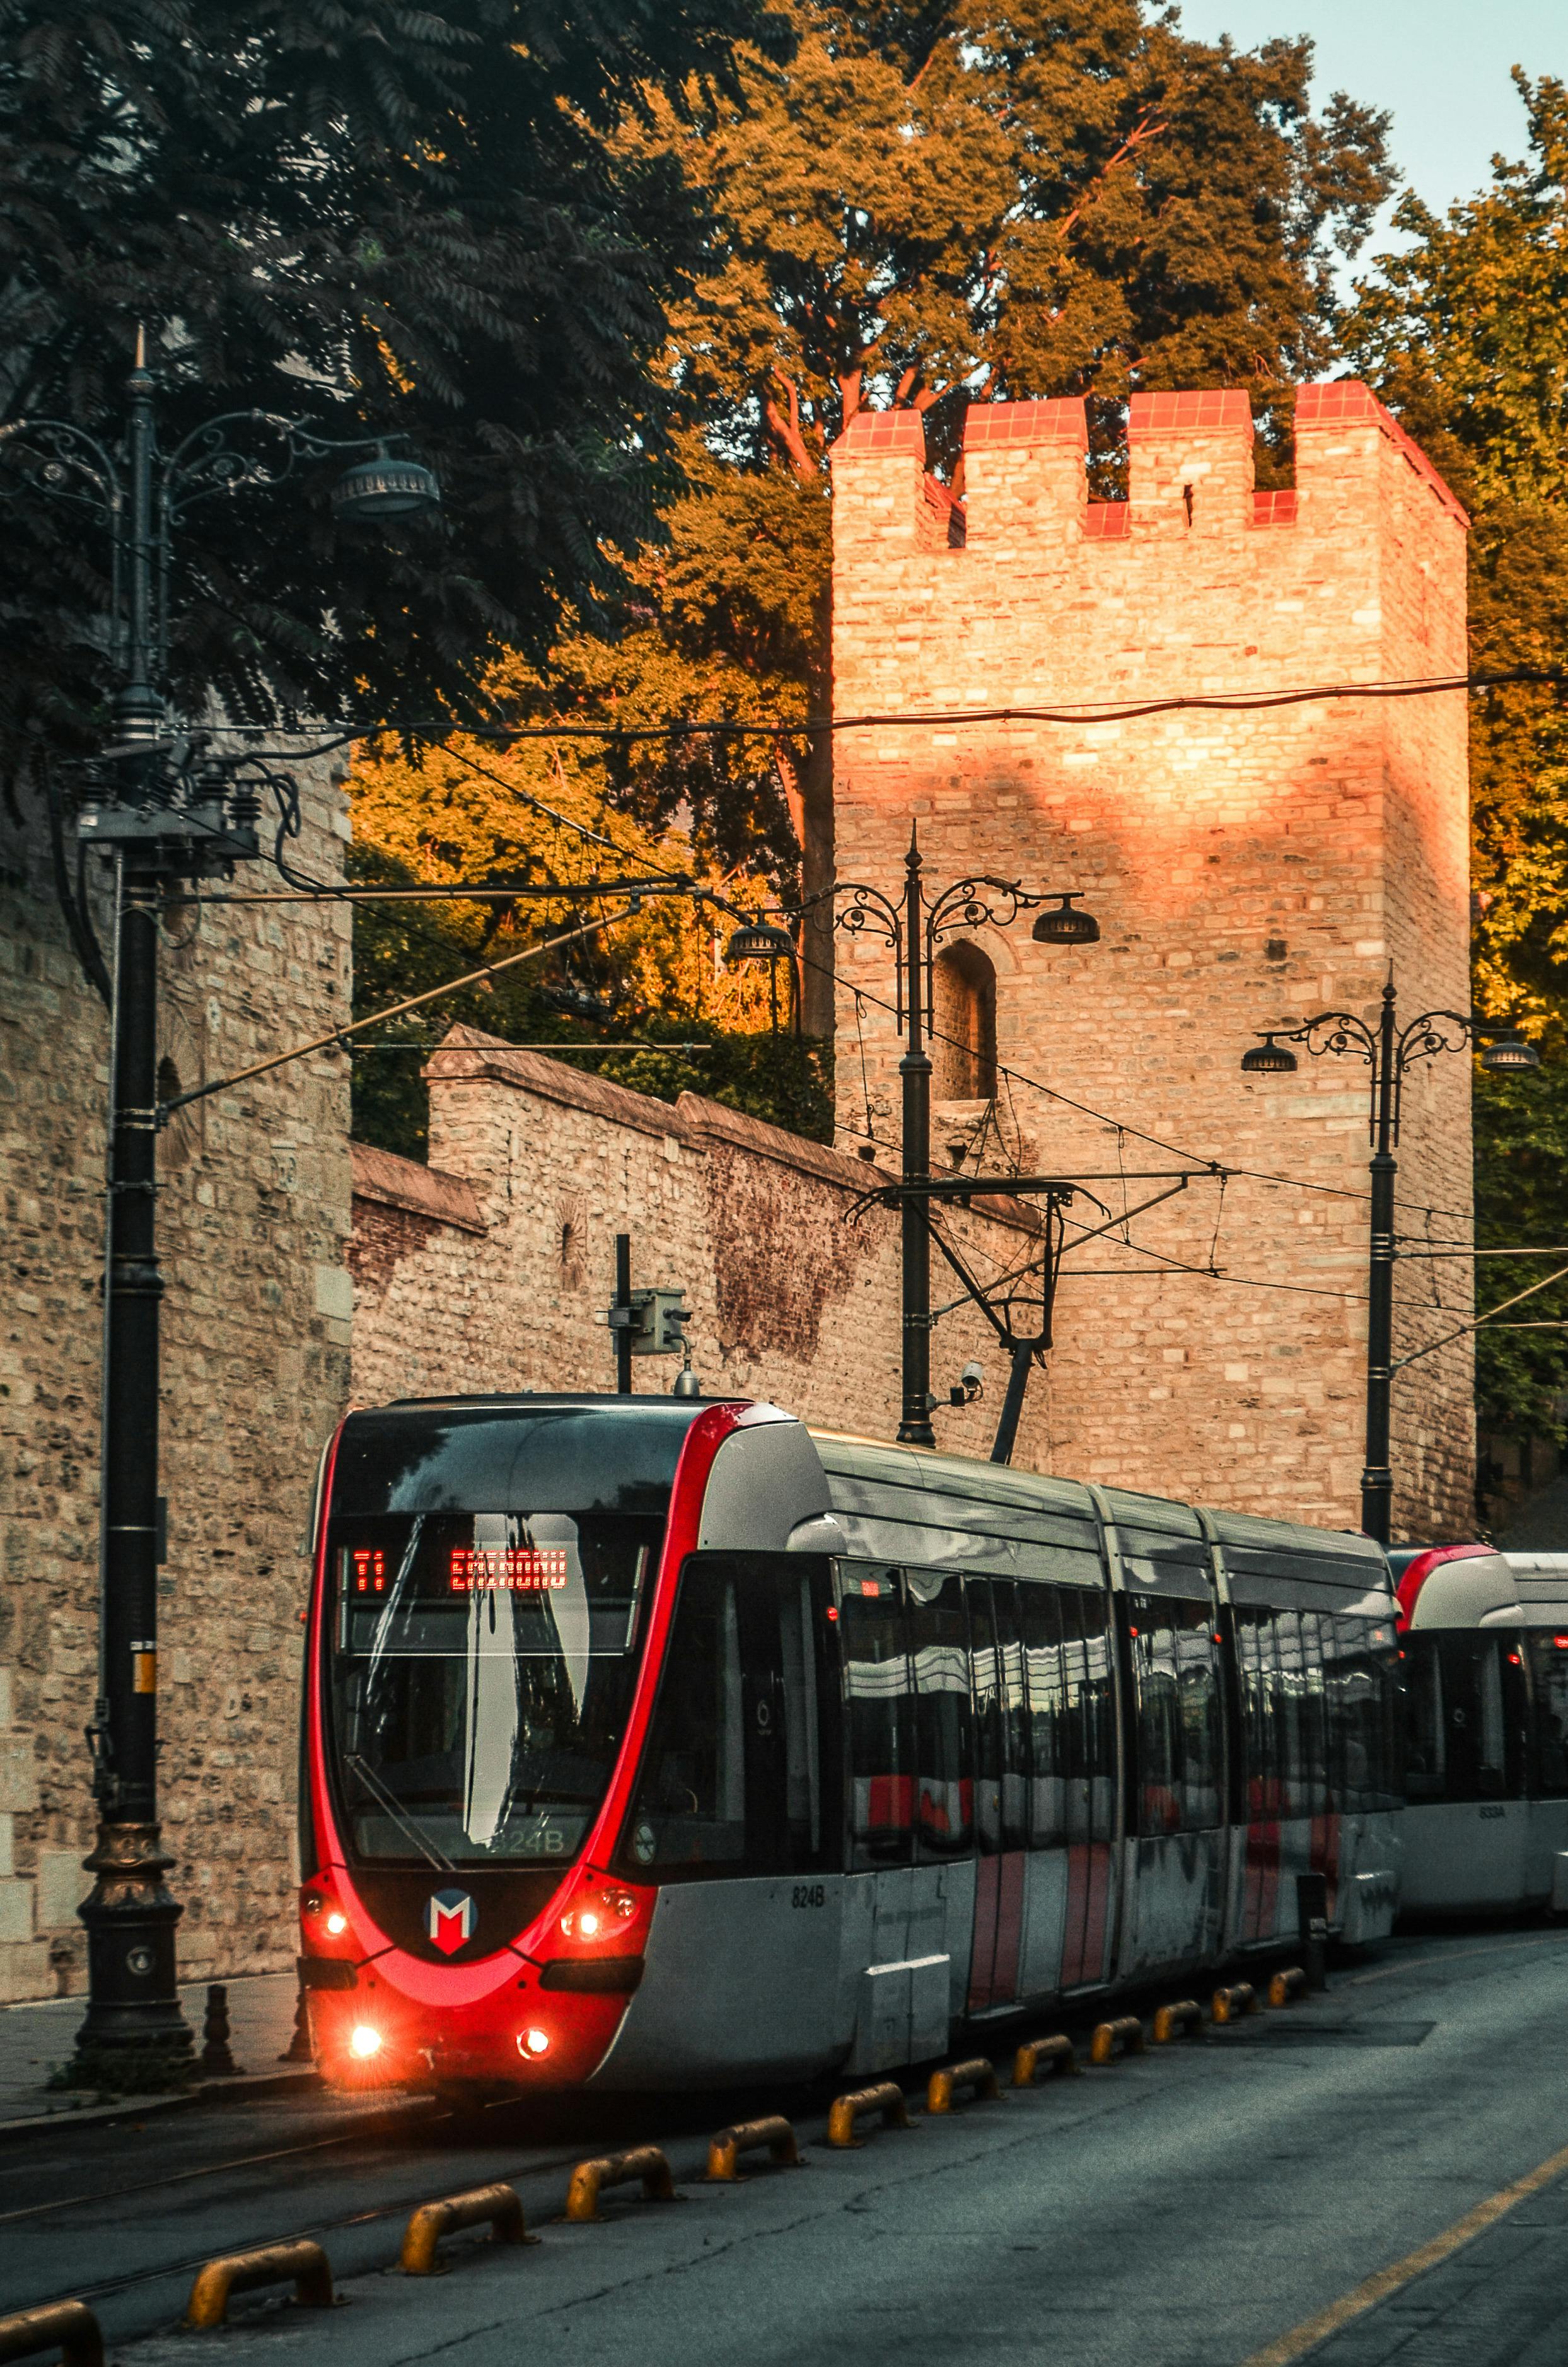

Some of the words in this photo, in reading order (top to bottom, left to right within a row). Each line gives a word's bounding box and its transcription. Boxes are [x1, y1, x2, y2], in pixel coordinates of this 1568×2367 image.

[354, 1550, 383, 1591] T1
[792, 1884, 825, 1909] 824B
[429, 1895, 472, 1940] M
